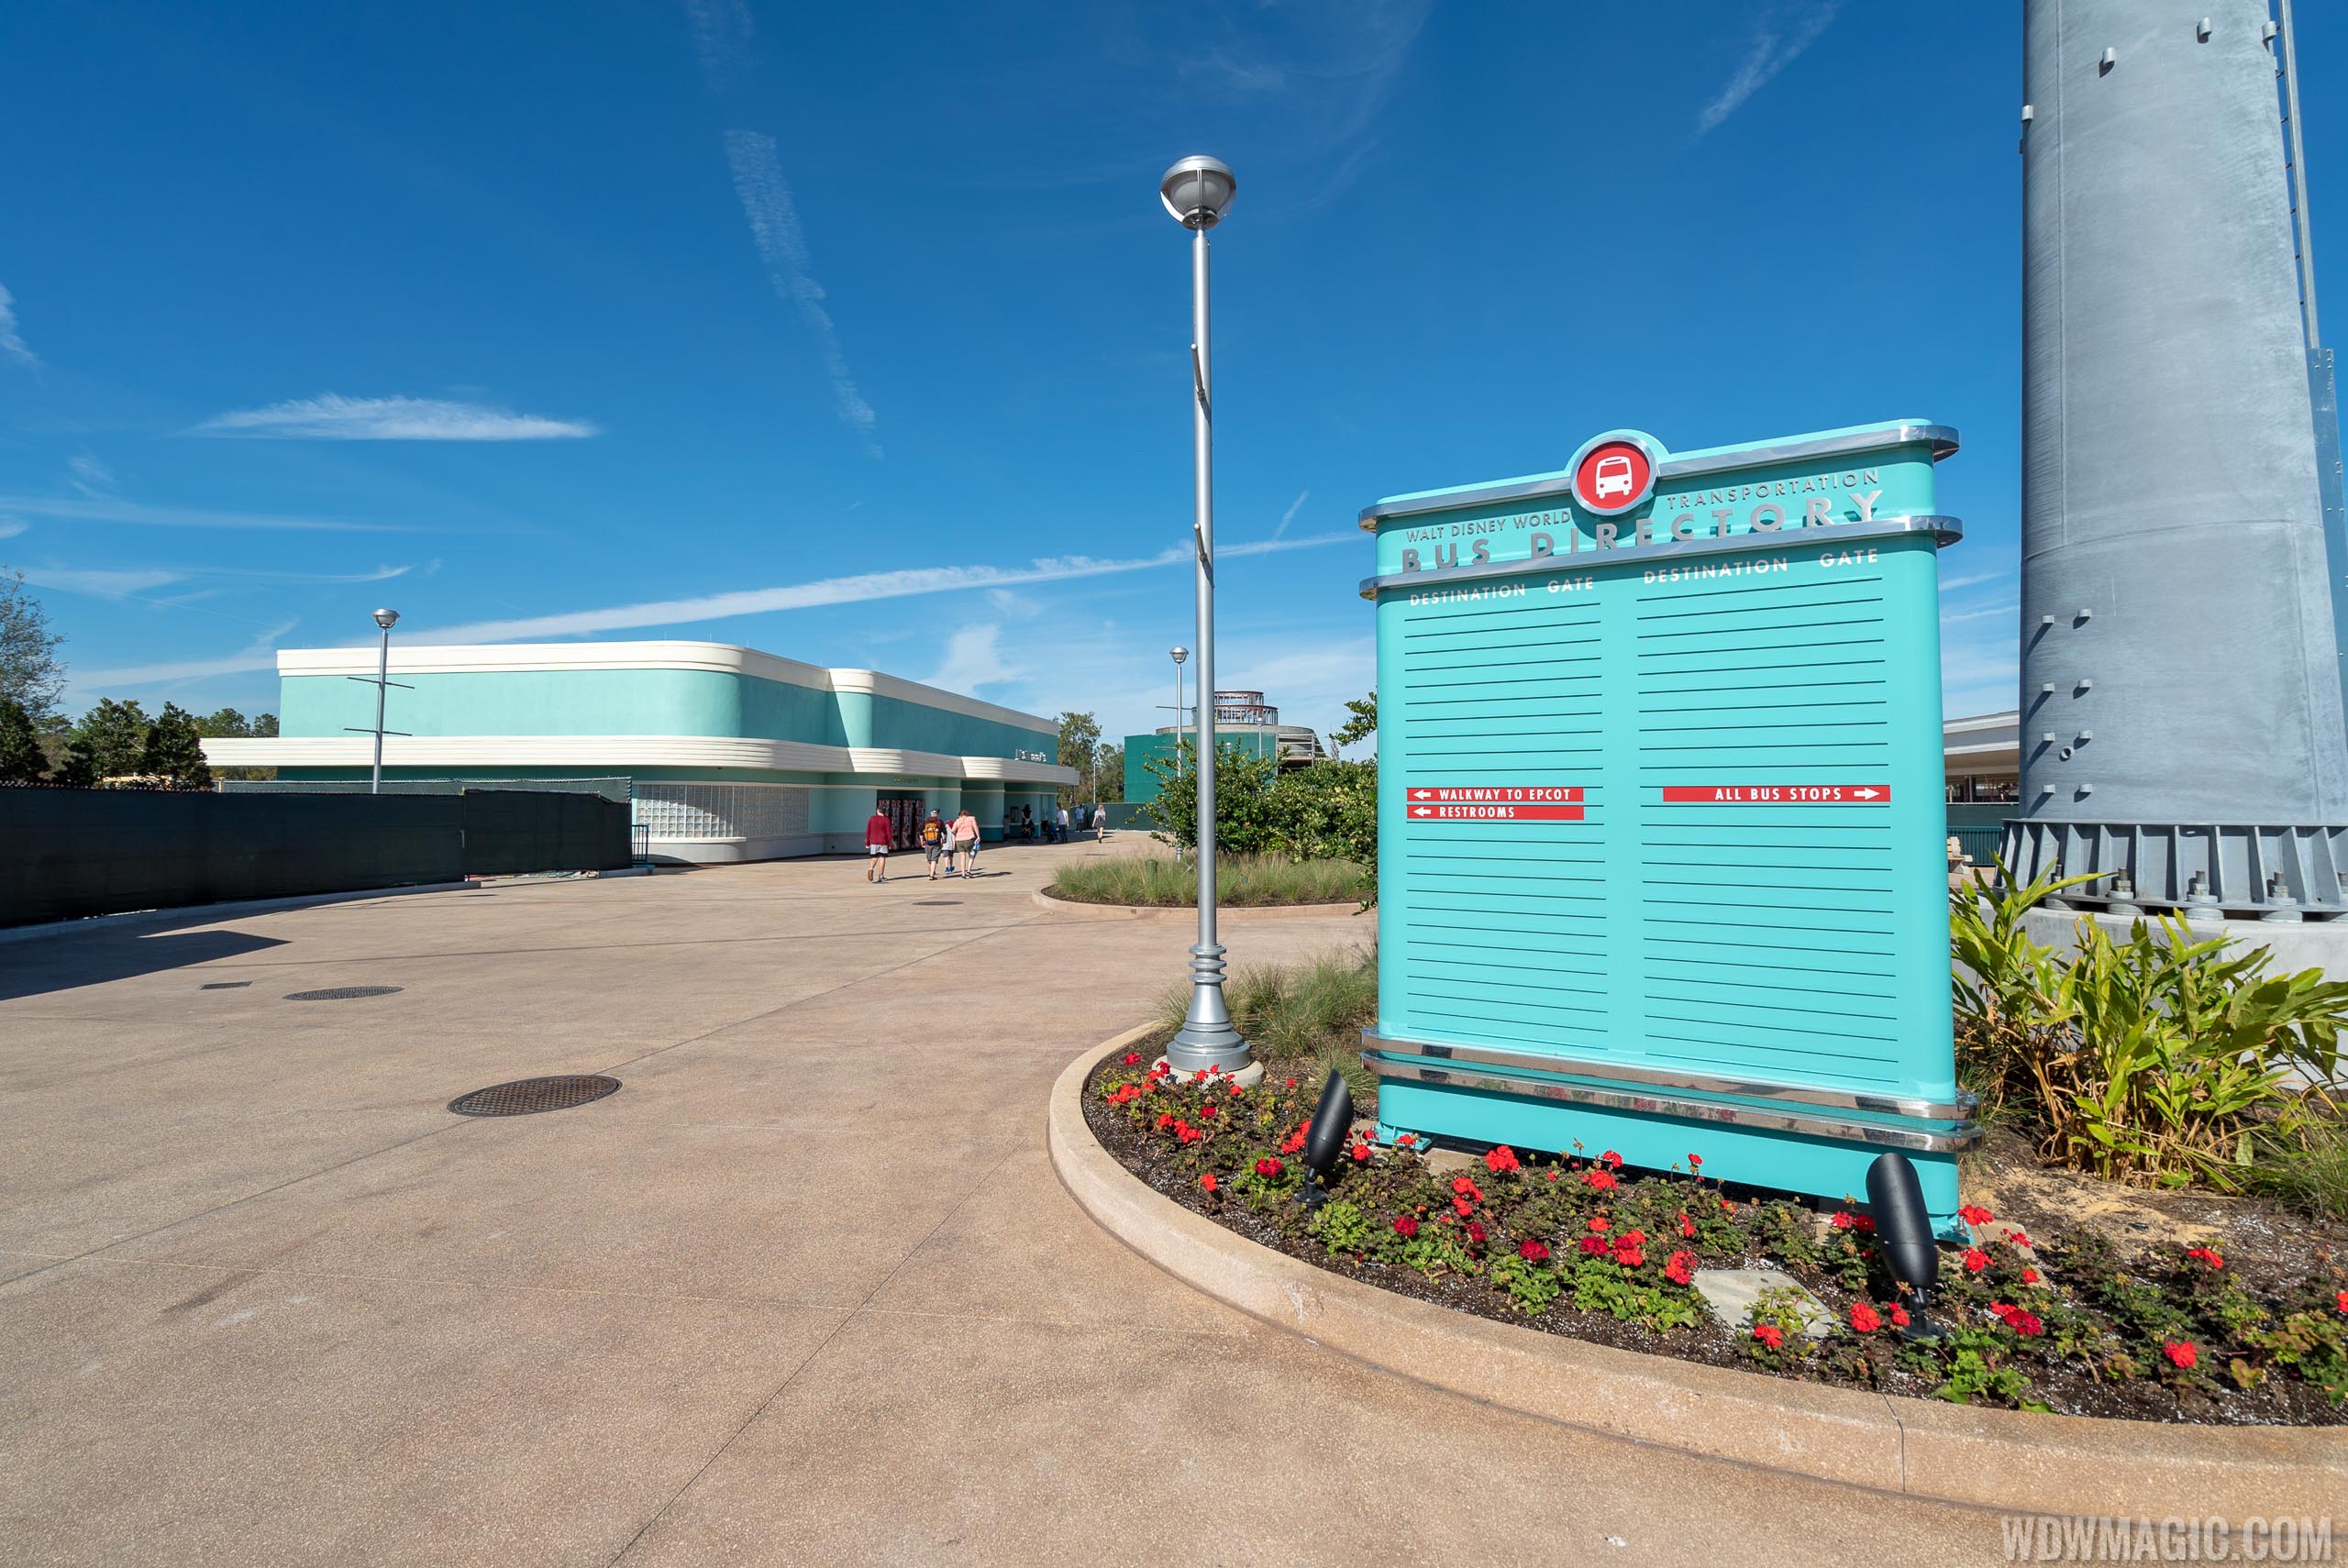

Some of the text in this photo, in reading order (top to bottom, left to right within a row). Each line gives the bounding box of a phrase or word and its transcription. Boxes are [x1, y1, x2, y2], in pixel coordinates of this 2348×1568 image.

[1405, 469, 1878, 544] WALT DISNEY WORLD TRANSPORTATION
[1401, 490, 1883, 573] BUS DIRECTORY
[1644, 548, 1877, 584] DESTINATION GATE
[1410, 577, 1594, 607] DESTINATION GATE
[1439, 789, 1570, 801] WALKWAY TO EPCOT
[1715, 788, 1842, 801] ALL BUS STOPS
[1439, 806, 1515, 818] RESTROOMS
